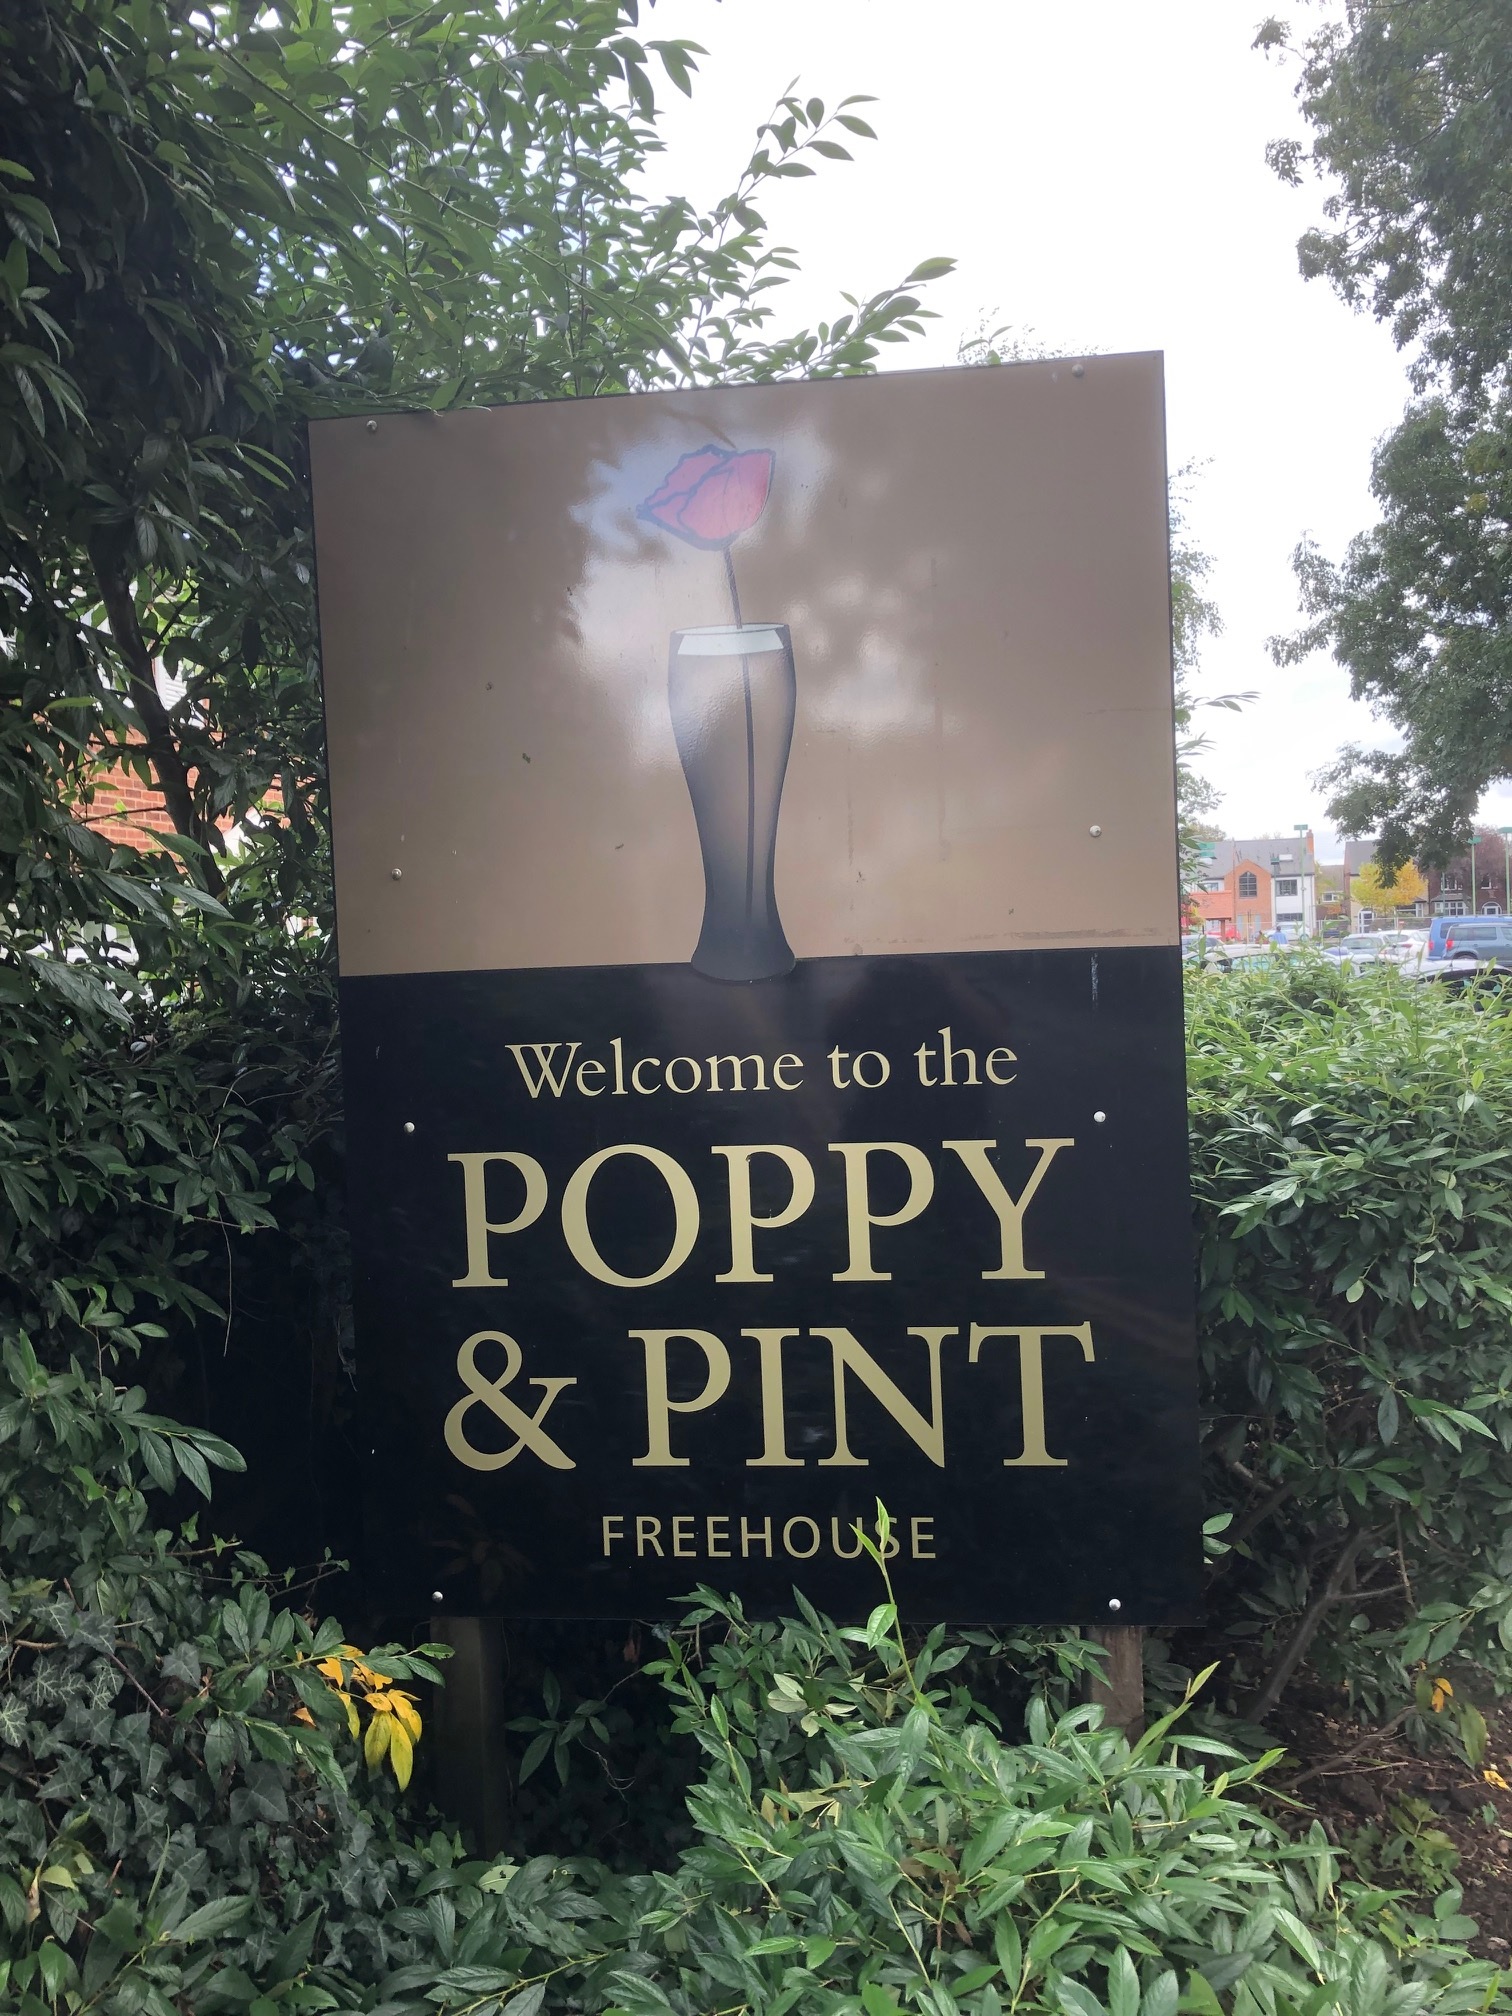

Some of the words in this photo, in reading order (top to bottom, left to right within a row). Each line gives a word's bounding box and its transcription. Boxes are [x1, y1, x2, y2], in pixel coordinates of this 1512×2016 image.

[504, 1036, 804, 1099] Welcome
[826, 1044, 891, 1090] to
[912, 1025, 1018, 1087] the
[446, 1137, 1075, 1288] POPPY
[443, 1330, 578, 1472] &
[627, 1320, 1096, 1469] PINT
[602, 1515, 936, 1559] FREEHOUSE
